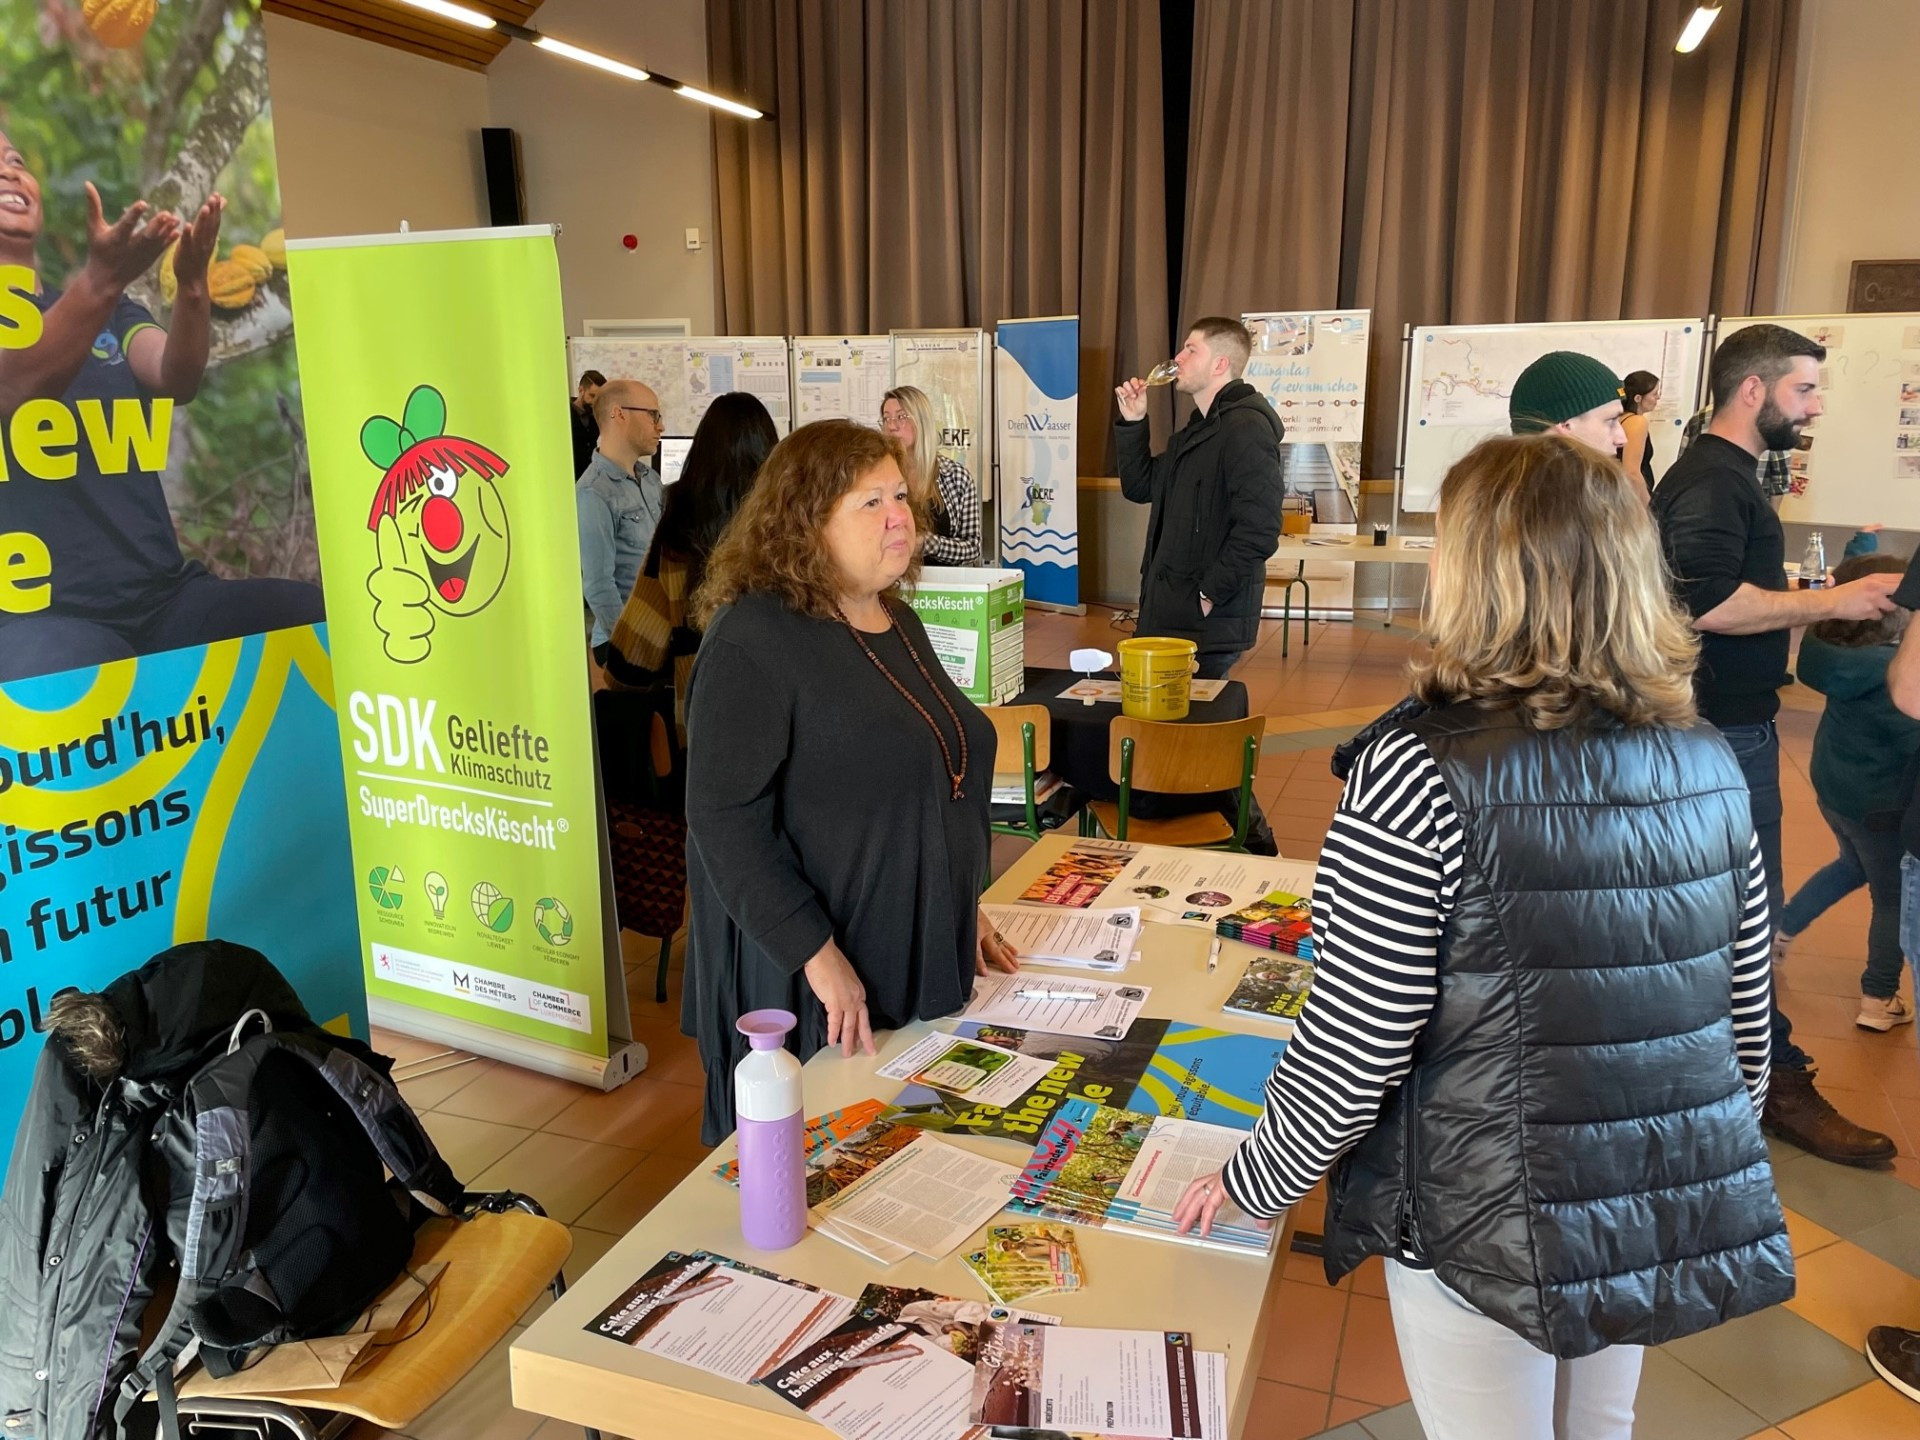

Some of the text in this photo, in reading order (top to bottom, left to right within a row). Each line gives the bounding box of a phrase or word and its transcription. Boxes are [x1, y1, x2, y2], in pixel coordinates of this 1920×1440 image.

[1270, 377, 1358, 395] Gevenmcher
[349, 690, 549, 774] SDK Geliefte
[450, 753, 552, 790] Klimaschutz
[0, 790, 190, 892] issons
[26, 870, 171, 951] futur
[532, 944, 580, 961] CIRCULAR ECONOMY
[474, 976, 506, 990] CHAMBRE
[475, 985, 517, 1001] DES MÉTIERS
[532, 990, 565, 1004] CHAMBER
[543, 1002, 581, 1017] COMMERCE
[1003, 1094, 1056, 1134] the
[1036, 1050, 1085, 1096] new
[1175, 1086, 1189, 1103] nous
[1183, 1057, 1203, 1086] agissons
[955, 1104, 1001, 1127] Fa
[1034, 1129, 1075, 1181] Fairtrade News
[599, 1291, 648, 1332] Cake aux
[612, 1261, 701, 1337] bananes Fairtrade
[788, 1323, 895, 1399] bananes Fairtrade
[980, 1325, 1006, 1368] Gâteau
[776, 1349, 834, 1390] Cake aux
